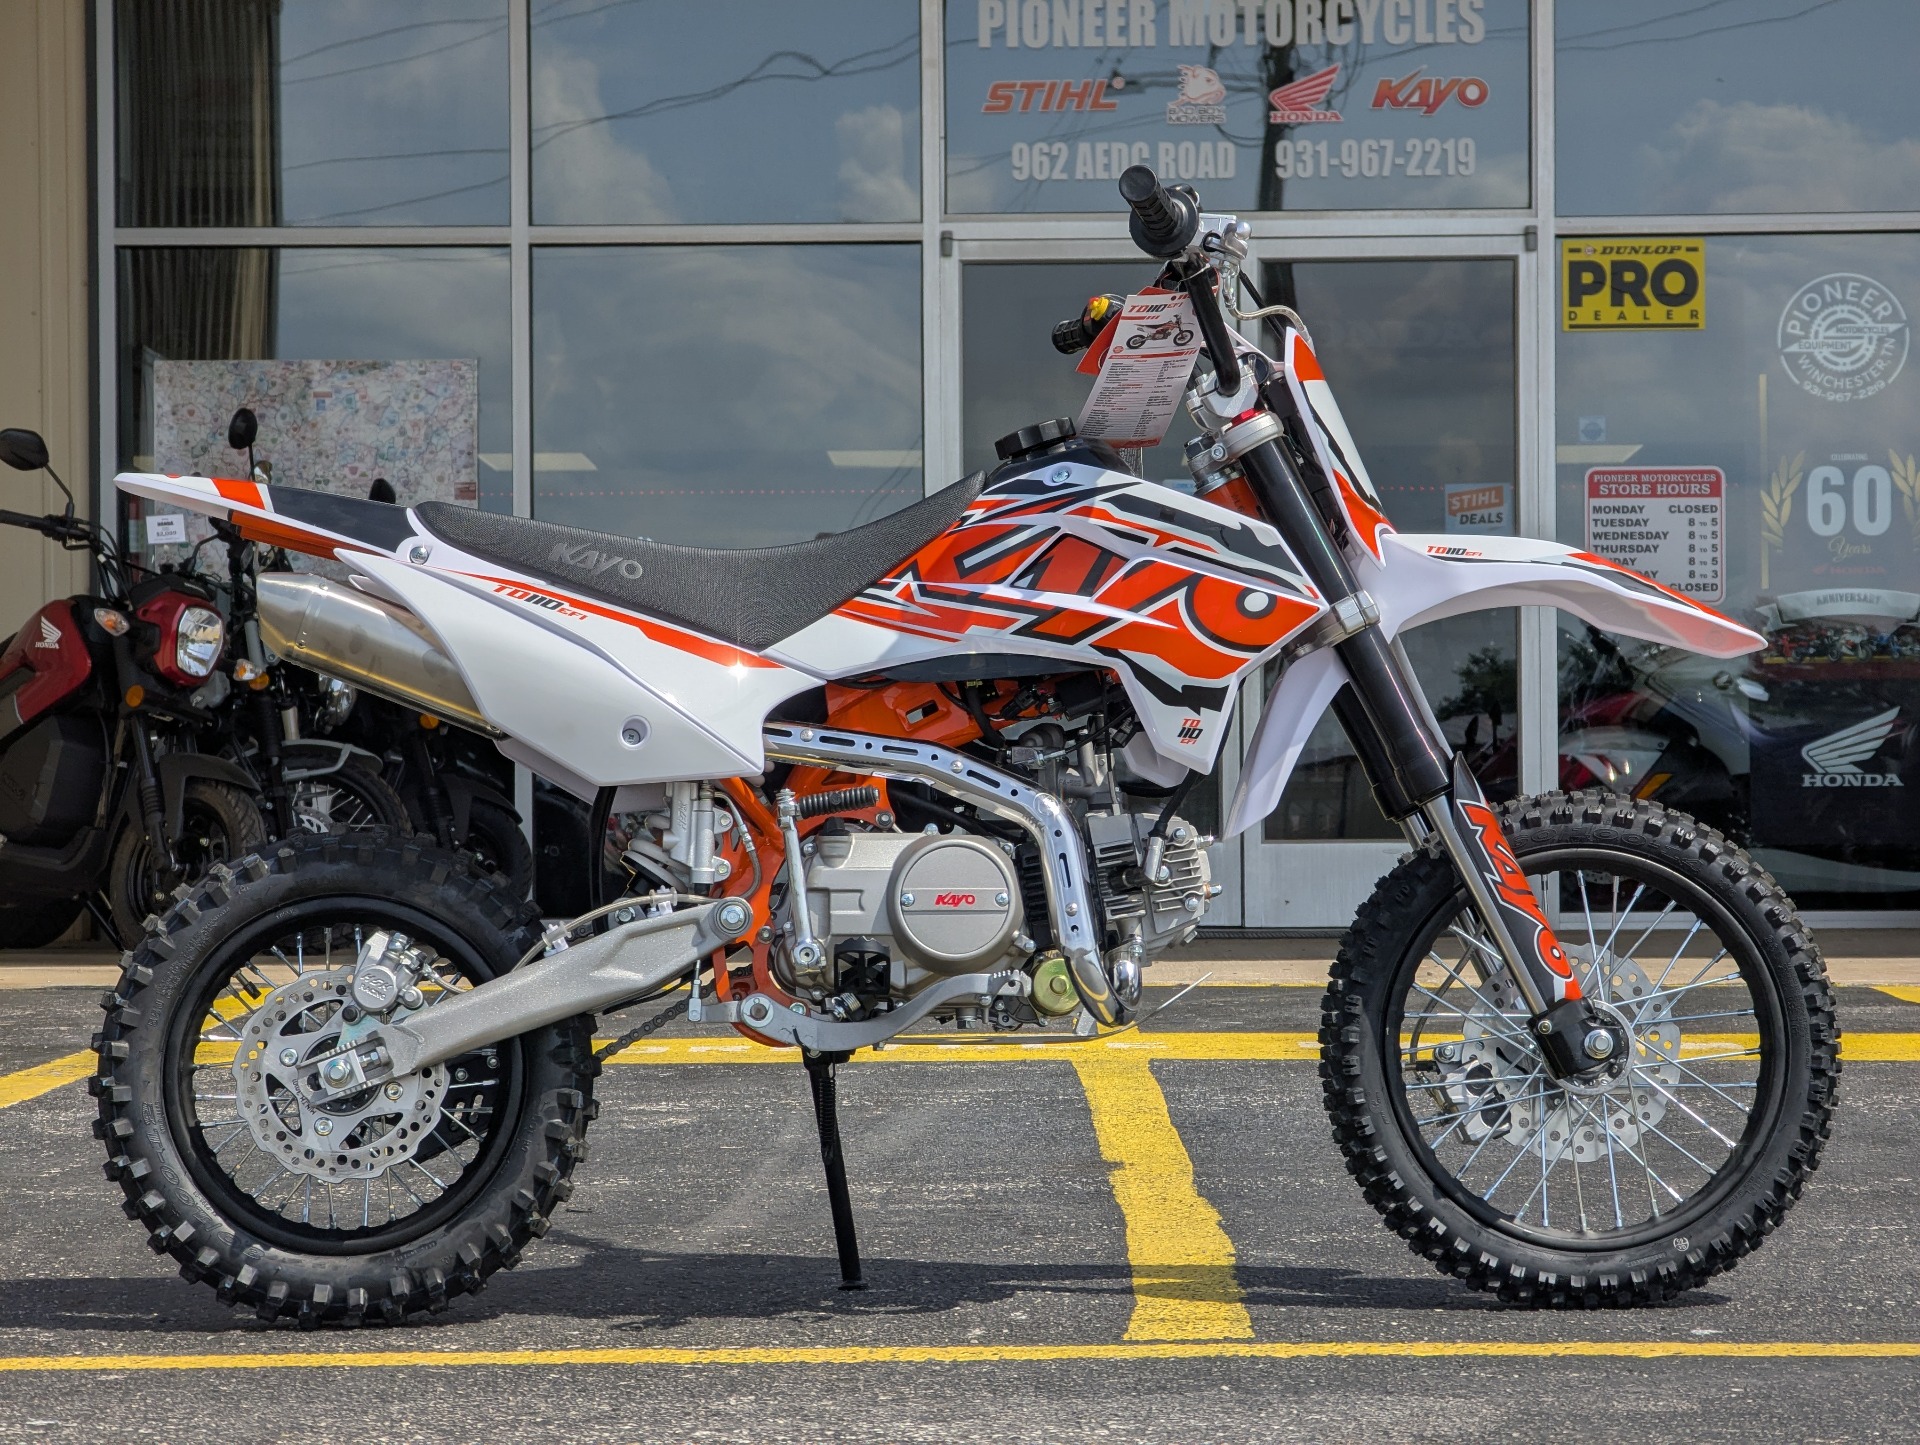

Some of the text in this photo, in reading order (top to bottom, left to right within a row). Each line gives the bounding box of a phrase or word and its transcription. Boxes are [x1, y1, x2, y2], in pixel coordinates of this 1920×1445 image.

[978, 0, 1486, 48] PIONEER MOTORCYCLES
[981, 80, 1118, 113] STIHL
[1371, 65, 1489, 116] KAYO
[1168, 114, 1225, 124] MOWERS
[1270, 111, 1343, 123] HONDA
[1012, 140, 1236, 181] 962 AEDC ROAD
[1275, 137, 1476, 179] 931-967-2219
[1600, 245, 1682, 255] DUNLOP
[1568, 258, 1699, 308] PRO
[1786, 281, 1893, 336] PIONEER
[1568, 310, 1699, 321] DEALER
[1799, 341, 1853, 350] EQUIPMENT
[1594, 473, 1717, 482] PIONEER MOTORCYCLES
[1600, 483, 1711, 495] STORE HOURS
[1451, 490, 1499, 510] STIHL
[1807, 465, 1892, 536] 60
[1592, 504, 1718, 514] MONDAY CLOSED
[1460, 512, 1503, 525] DEALS
[1592, 518, 1650, 527] TUESDAY
[1688, 517, 1696, 526] 8
[1711, 517, 1718, 526] 5
[1592, 531, 1669, 541] WEDNESDAY
[1688, 530, 1696, 540] 8
[1711, 530, 1718, 540] 5
[1592, 544, 1659, 554] THURSDAY
[1688, 543, 1696, 553] 8
[1711, 543, 1718, 553] 5
[548, 542, 643, 579] KAYO
[1688, 556, 1696, 566] 8
[1711, 556, 1718, 566] 5
[1688, 569, 1696, 579] 8
[1711, 569, 1718, 579] 3
[1669, 582, 1718, 592] CLOSED
[1816, 592, 1882, 606] ANNIVERSARY
[35, 641, 60, 649] HONDA
[1182, 718, 1201, 728] TD
[1177, 727, 1203, 739] 110
[1802, 774, 1904, 787] HONDA
[935, 892, 976, 907] KAYO
